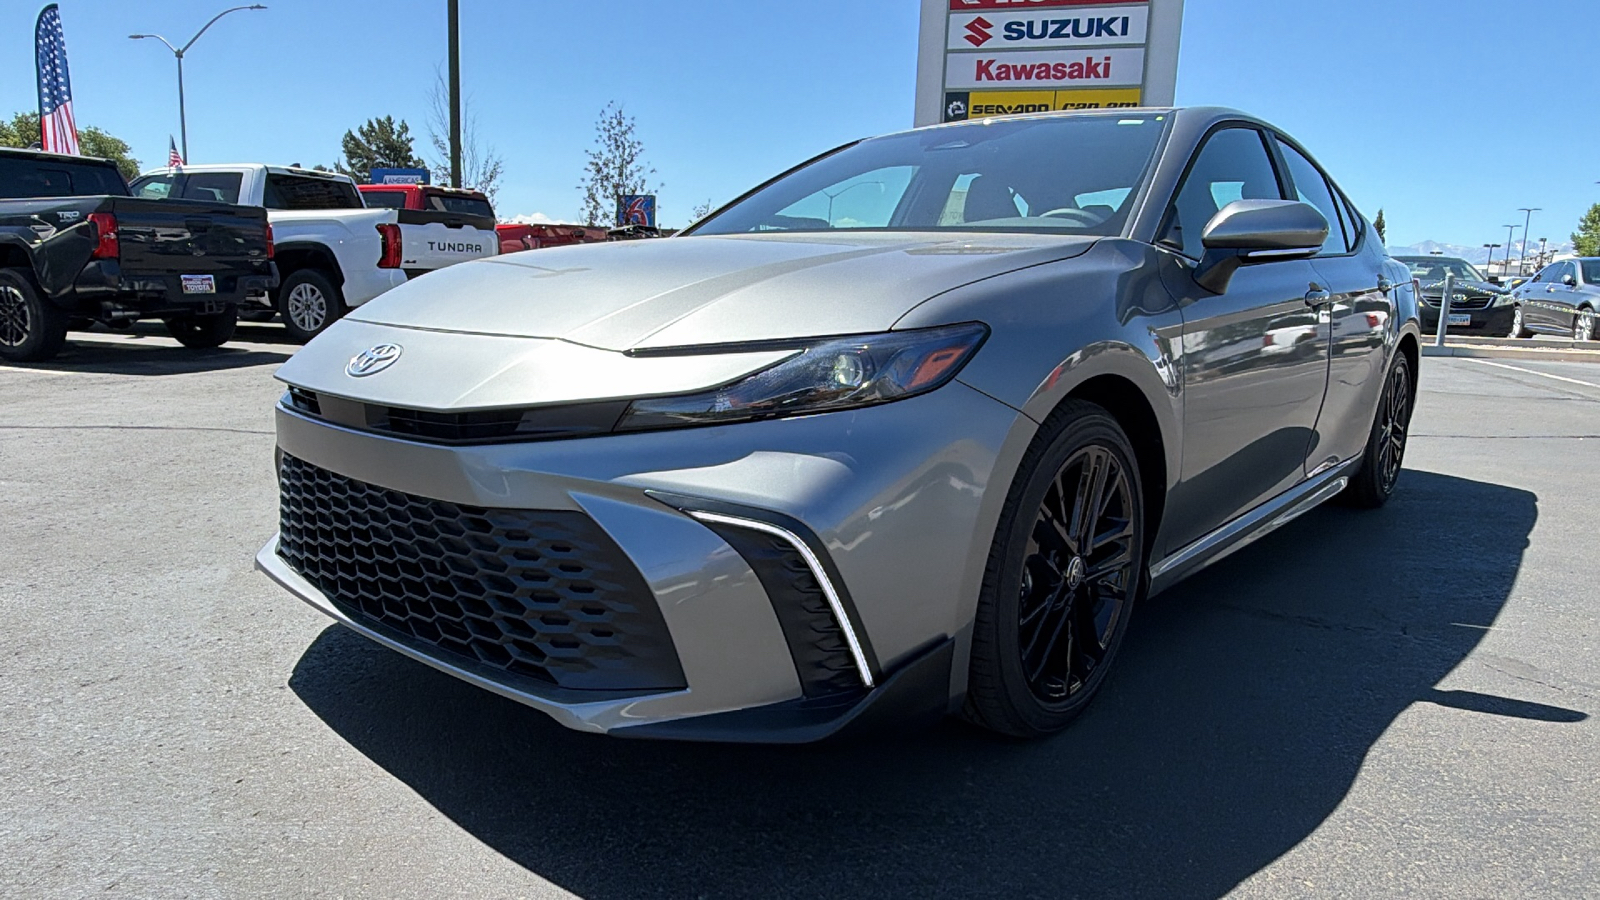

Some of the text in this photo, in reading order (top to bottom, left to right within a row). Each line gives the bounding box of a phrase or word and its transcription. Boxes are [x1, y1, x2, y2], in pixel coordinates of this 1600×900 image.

[1003, 16, 1129, 41] SUZUKI
[975, 56, 1111, 81] Kawasaki
[427, 241, 482, 253] TUNDRA
